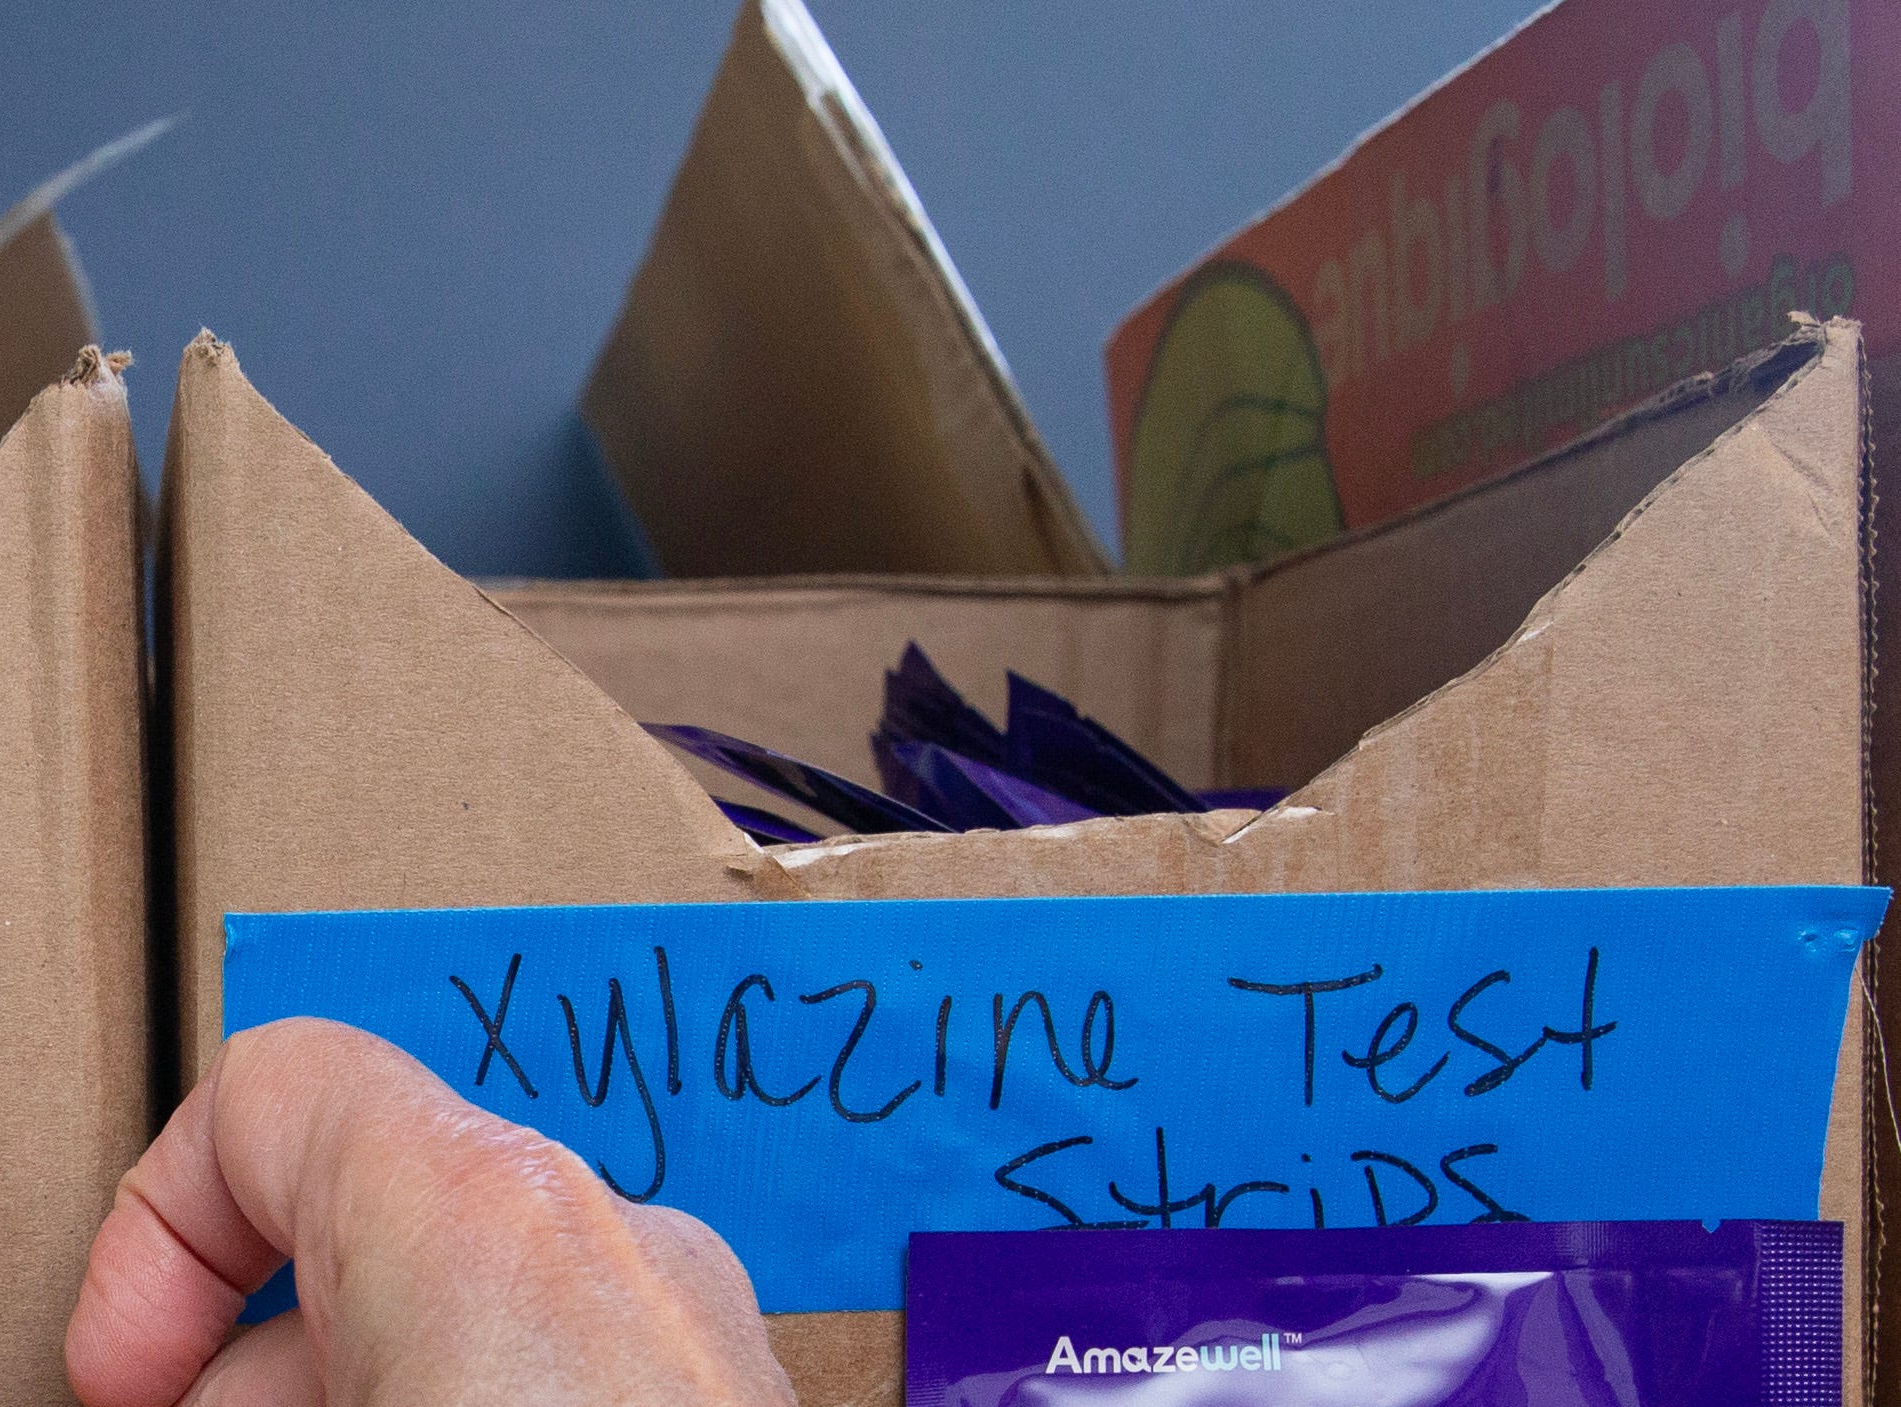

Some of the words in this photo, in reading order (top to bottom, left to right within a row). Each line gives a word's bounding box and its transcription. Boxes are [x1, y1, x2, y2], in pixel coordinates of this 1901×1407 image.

[1311, 0, 1855, 397] biologique
[450, 946, 1139, 1203] Xylazine
[1228, 947, 1618, 1105] Test
